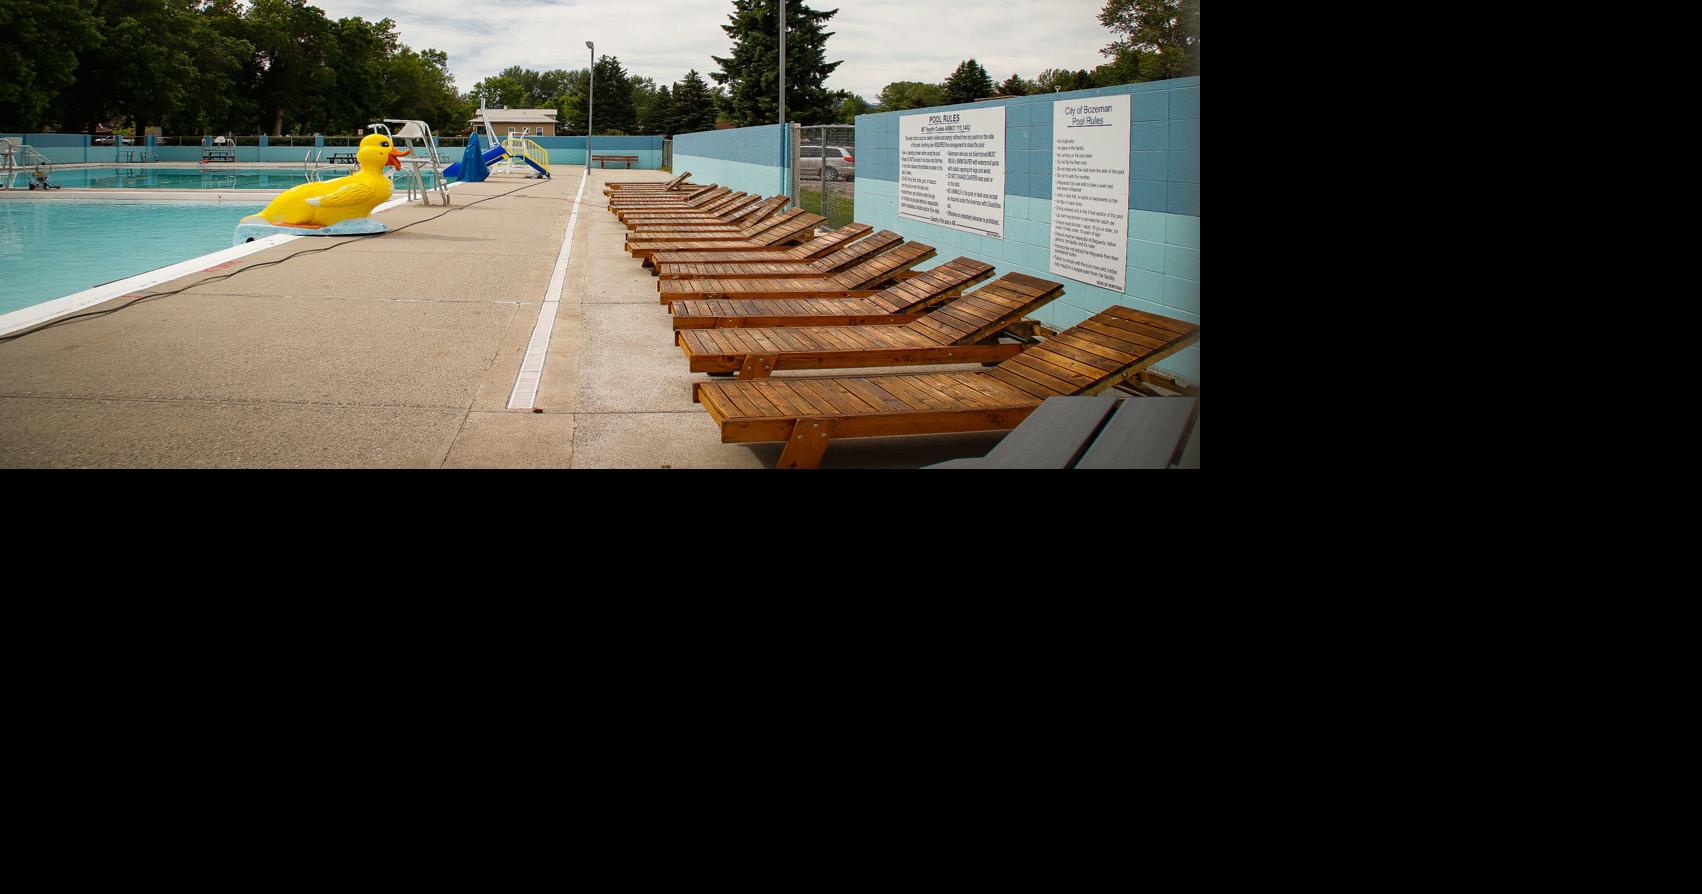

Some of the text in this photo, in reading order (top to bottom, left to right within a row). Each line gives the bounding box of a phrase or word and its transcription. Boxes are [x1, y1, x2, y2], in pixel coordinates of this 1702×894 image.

[1064, 105, 1112, 116] City of Bozeman
[929, 114, 960, 123] POOL RULES
[1072, 116, 1104, 125] Pool Rules
